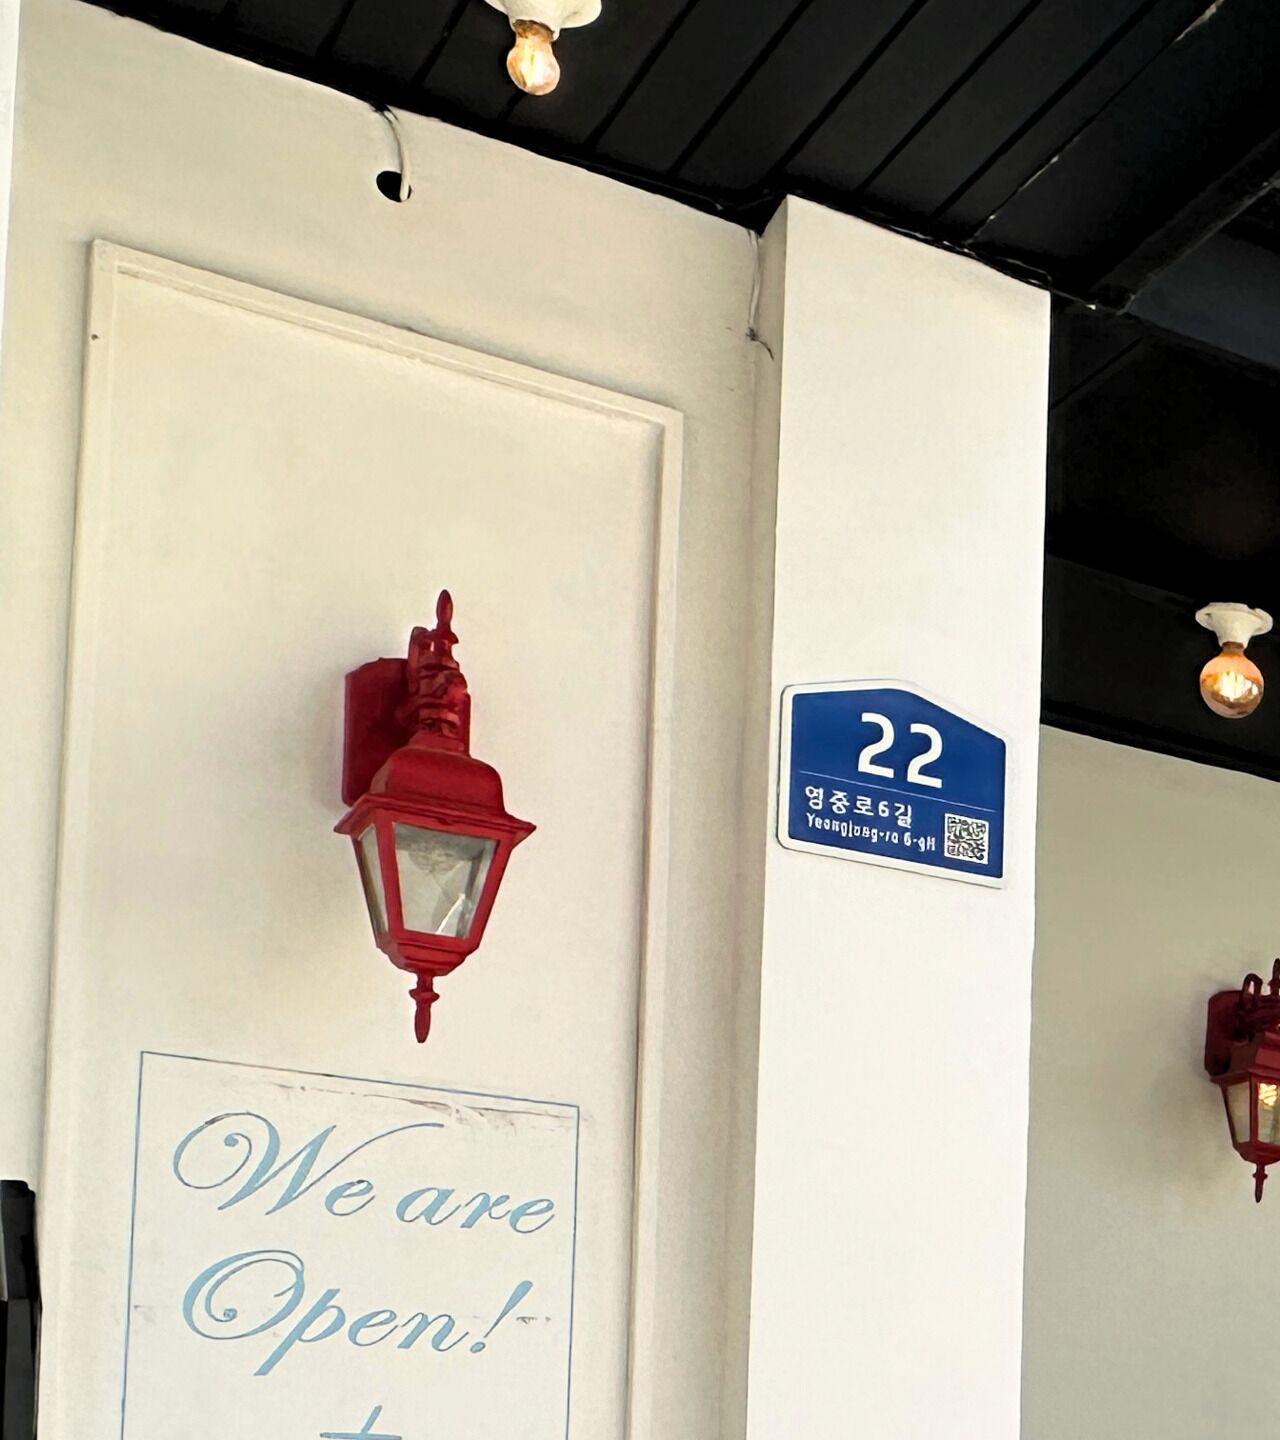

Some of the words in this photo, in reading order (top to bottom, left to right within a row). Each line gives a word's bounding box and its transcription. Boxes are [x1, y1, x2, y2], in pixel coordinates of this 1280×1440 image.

[857, 712, 943, 789] 22
[804, 785, 912, 829] 영중로6길
[172, 1111, 445, 1216] We
[395, 1186, 556, 1234] are
[182, 1249, 534, 1377] Open!
